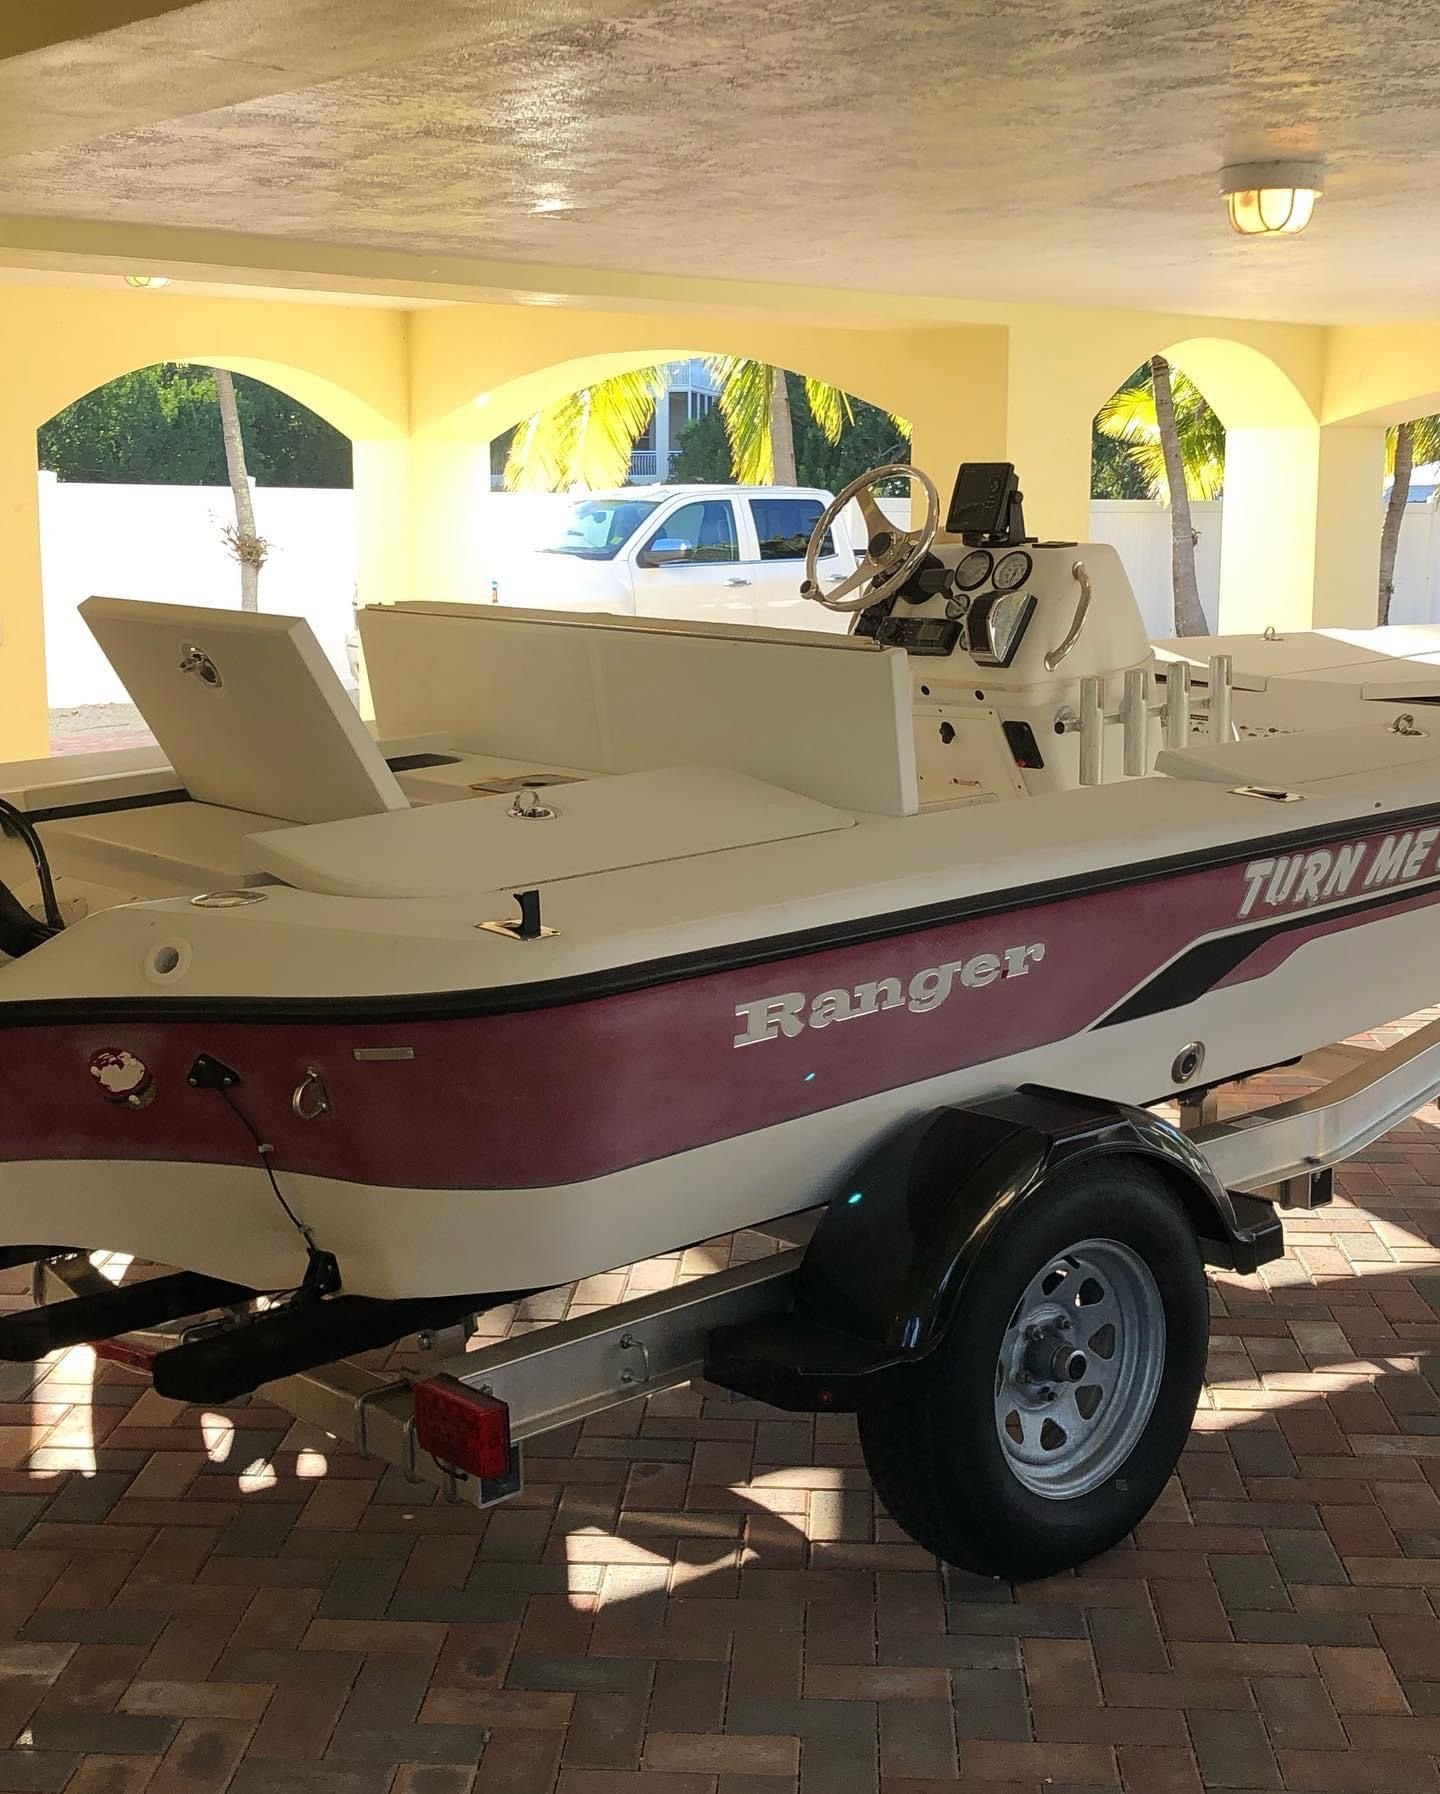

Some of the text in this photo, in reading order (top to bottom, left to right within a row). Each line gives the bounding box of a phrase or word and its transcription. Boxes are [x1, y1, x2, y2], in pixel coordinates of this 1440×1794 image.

[1237, 826, 1440, 919] TURN ME
[733, 942, 1046, 1048] Ranger
